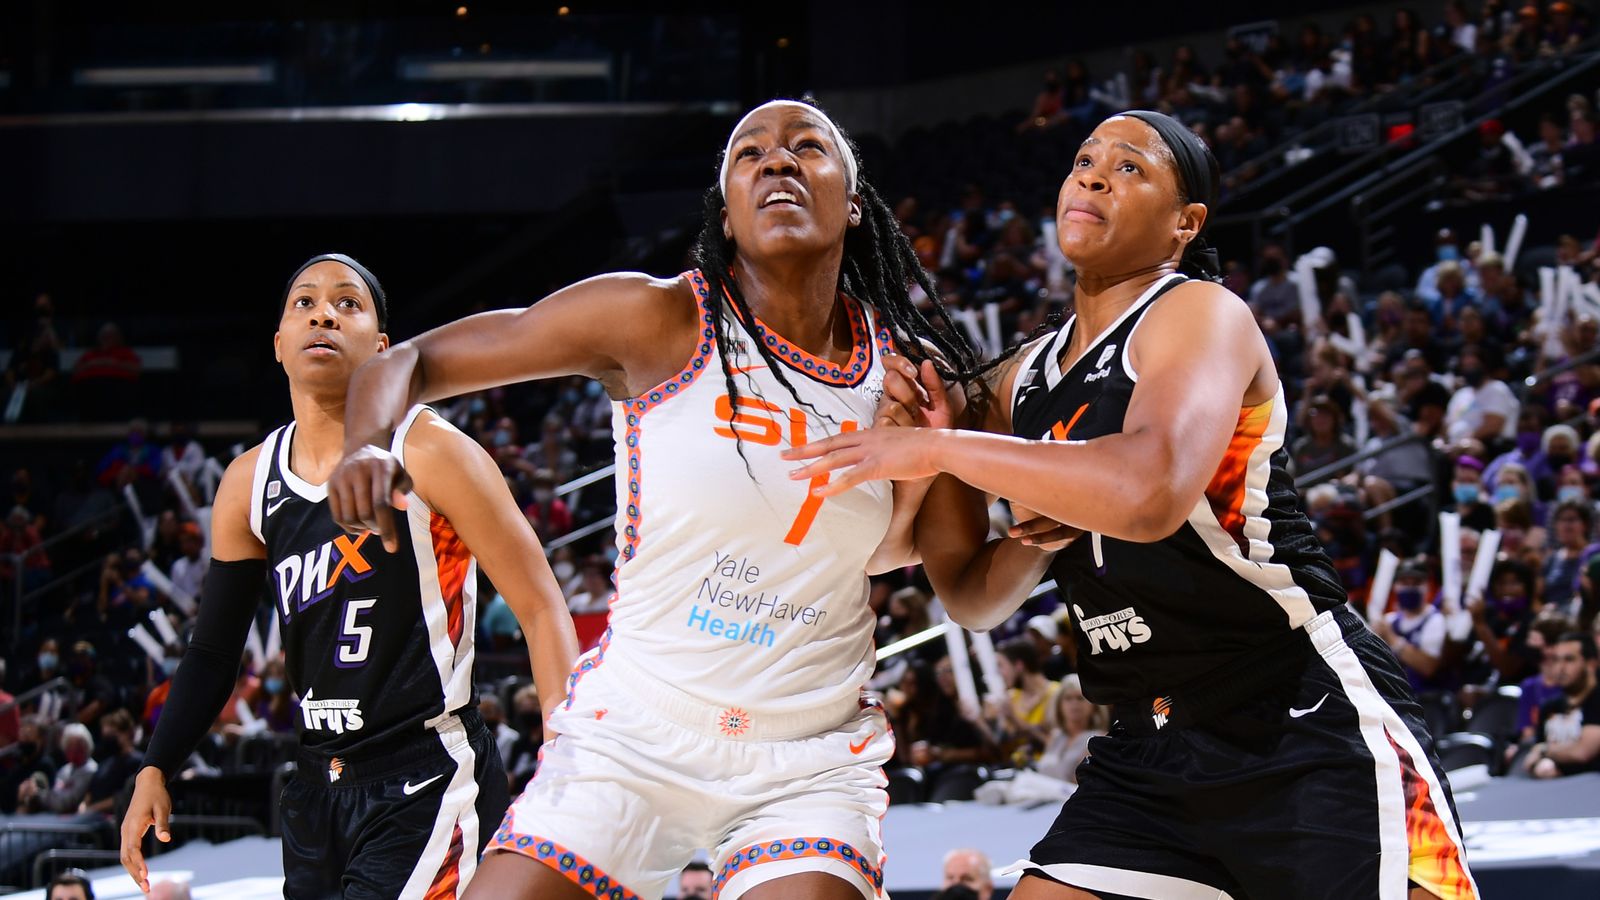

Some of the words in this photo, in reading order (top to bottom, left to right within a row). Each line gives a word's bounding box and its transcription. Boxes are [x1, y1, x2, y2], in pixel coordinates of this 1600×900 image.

[1084, 366, 1112, 384] PayPal
[275, 530, 373, 617] PHX
[712, 551, 760, 584] Yale
[338, 598, 377, 663] 5
[687, 604, 775, 648] Health
